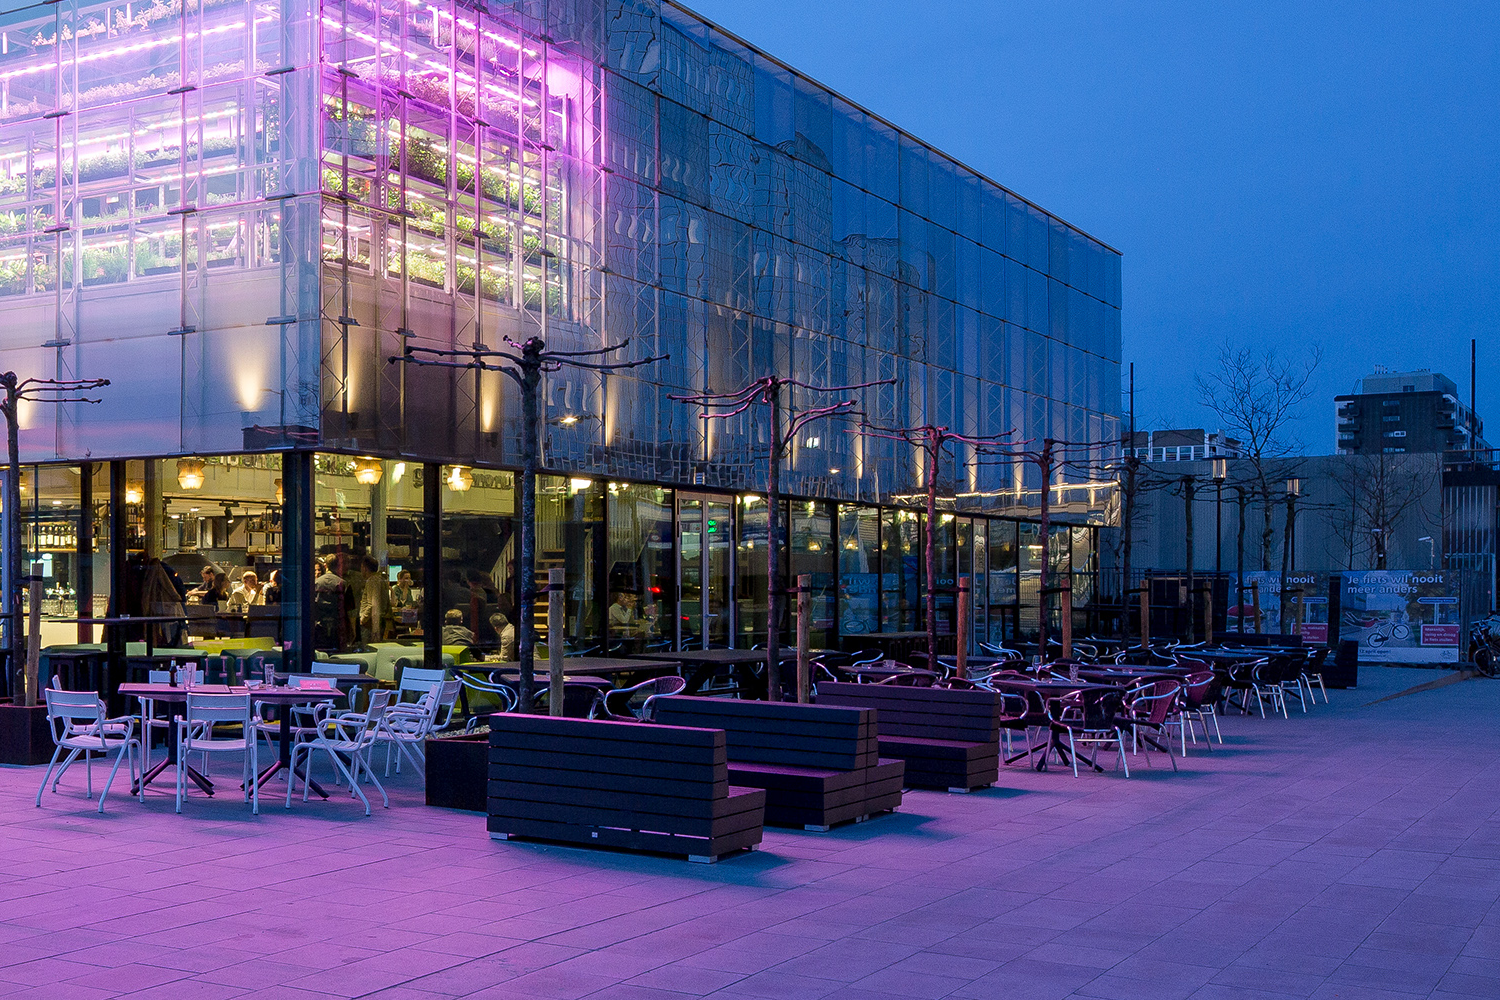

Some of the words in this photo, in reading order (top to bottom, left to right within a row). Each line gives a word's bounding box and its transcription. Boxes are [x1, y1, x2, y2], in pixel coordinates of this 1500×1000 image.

[1286, 575, 1315, 584] nooit
[1347, 575, 1359, 585] Je
[1363, 574, 1387, 585] fiets
[1389, 574, 1408, 584] wil
[1412, 574, 1444, 584] nooit
[1259, 585, 1292, 594] andes
[1347, 586, 1376, 594] meer
[1379, 585, 1418, 594] anders
